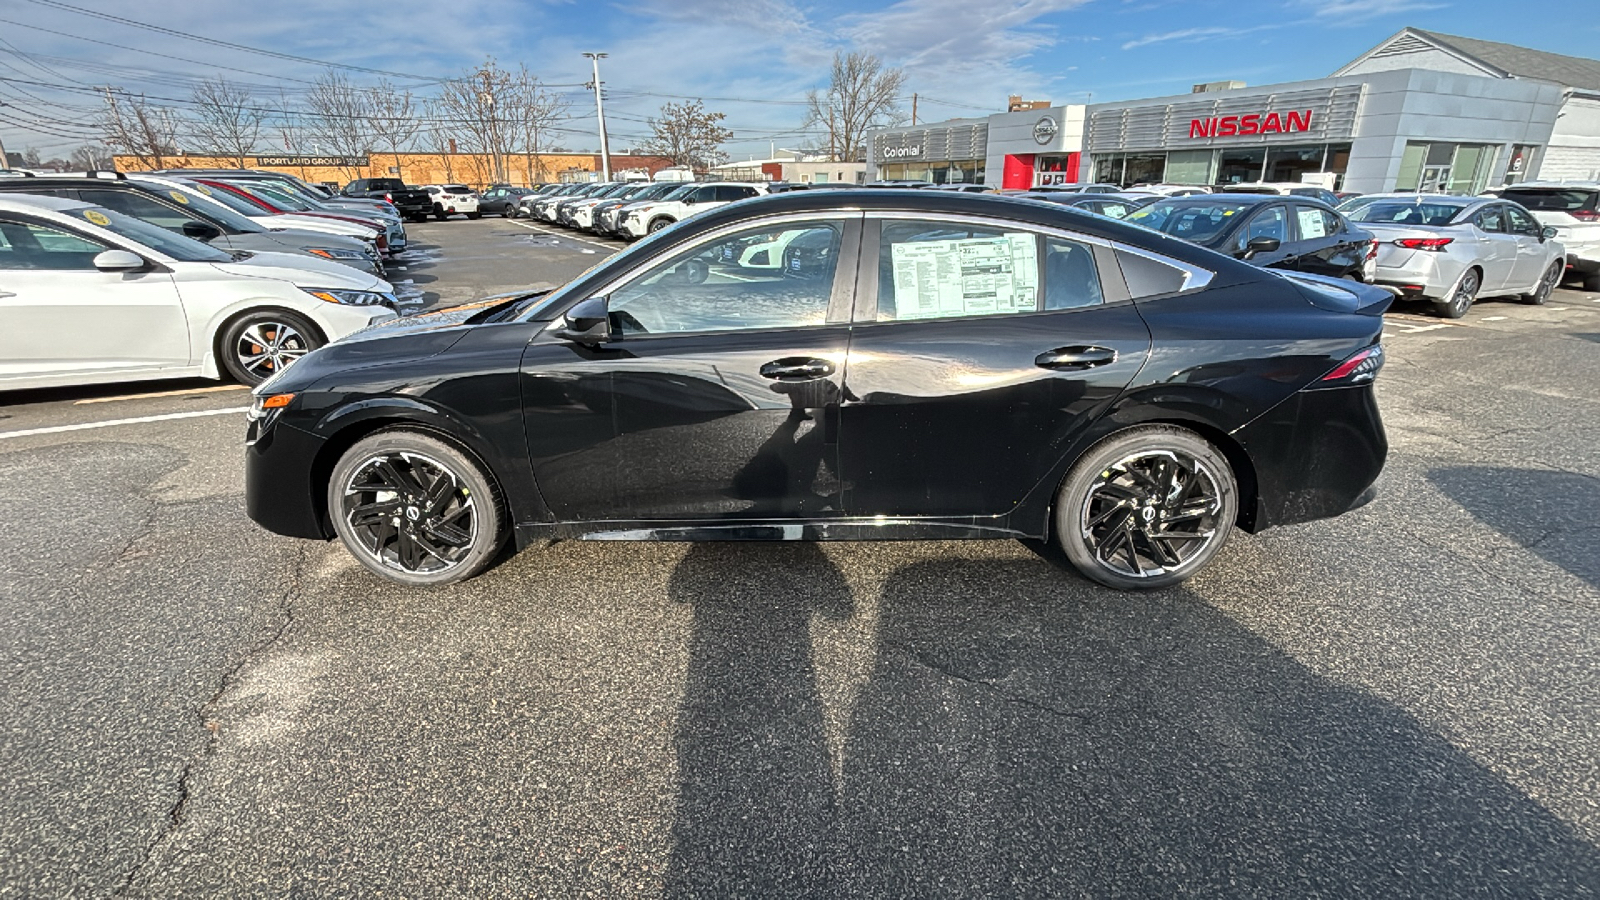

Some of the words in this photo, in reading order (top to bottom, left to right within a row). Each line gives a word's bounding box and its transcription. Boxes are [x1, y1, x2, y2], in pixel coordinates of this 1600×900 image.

[1189, 110, 1312, 138] NISSAN
[884, 145, 920, 157] Colonial
[263, 157, 311, 165] PORTLAND
[311, 157, 342, 165] GROUP
